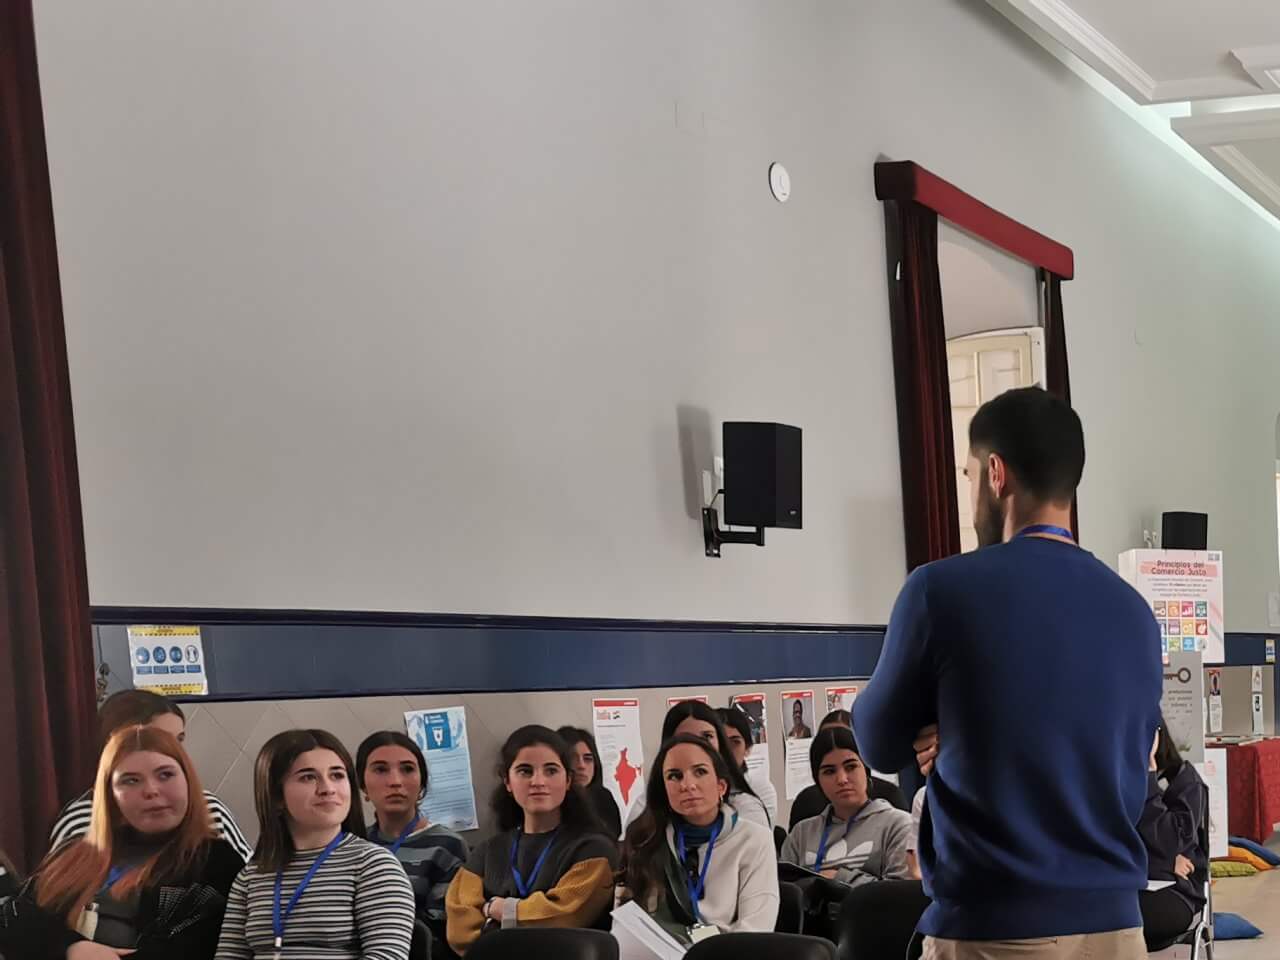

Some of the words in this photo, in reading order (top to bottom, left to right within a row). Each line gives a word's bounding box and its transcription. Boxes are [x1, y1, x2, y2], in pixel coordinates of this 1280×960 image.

[1156, 560, 1191, 568] Principios
[1151, 567, 1185, 575] Comercio
[1188, 568, 1207, 576] Justo
